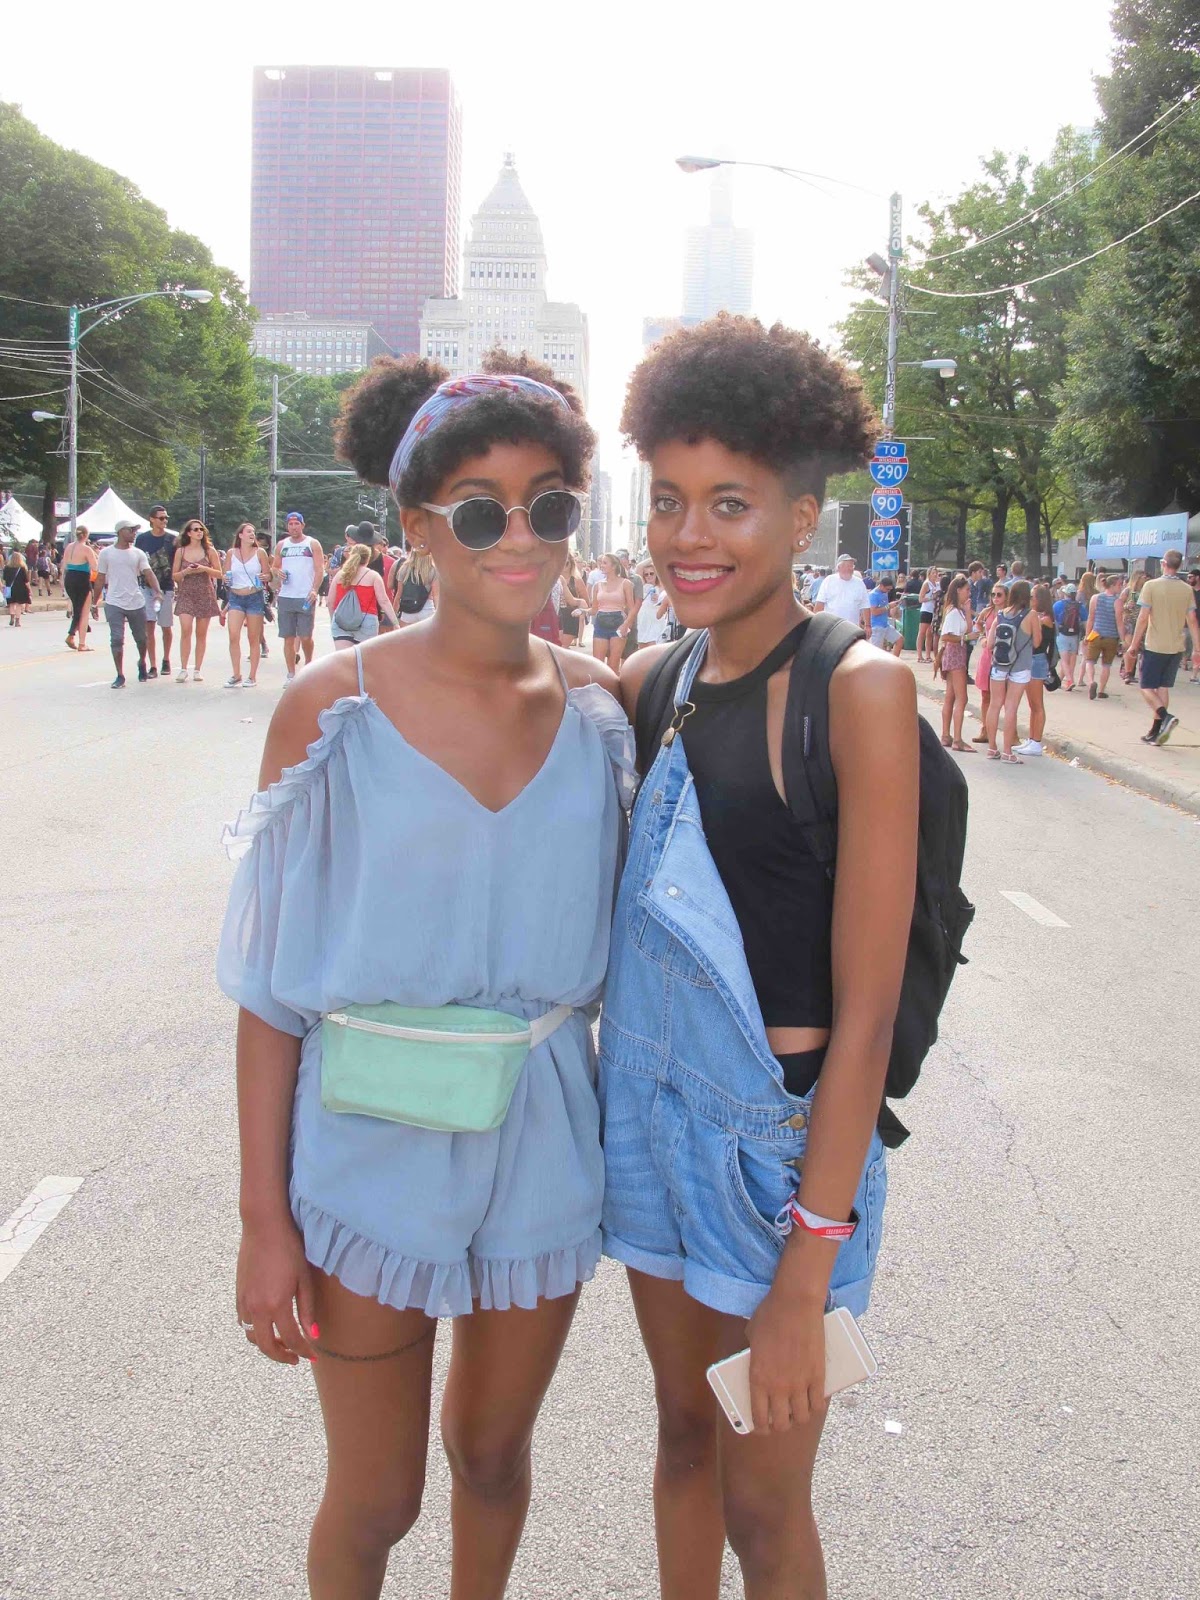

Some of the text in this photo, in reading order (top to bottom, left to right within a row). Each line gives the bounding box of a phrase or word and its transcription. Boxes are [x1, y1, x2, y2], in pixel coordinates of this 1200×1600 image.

[883, 445, 898, 455] TO
[877, 464, 903, 480] 290
[877, 496, 897, 511] 90
[875, 528, 895, 543] 94
[1132, 530, 1157, 546] LOUNGE
